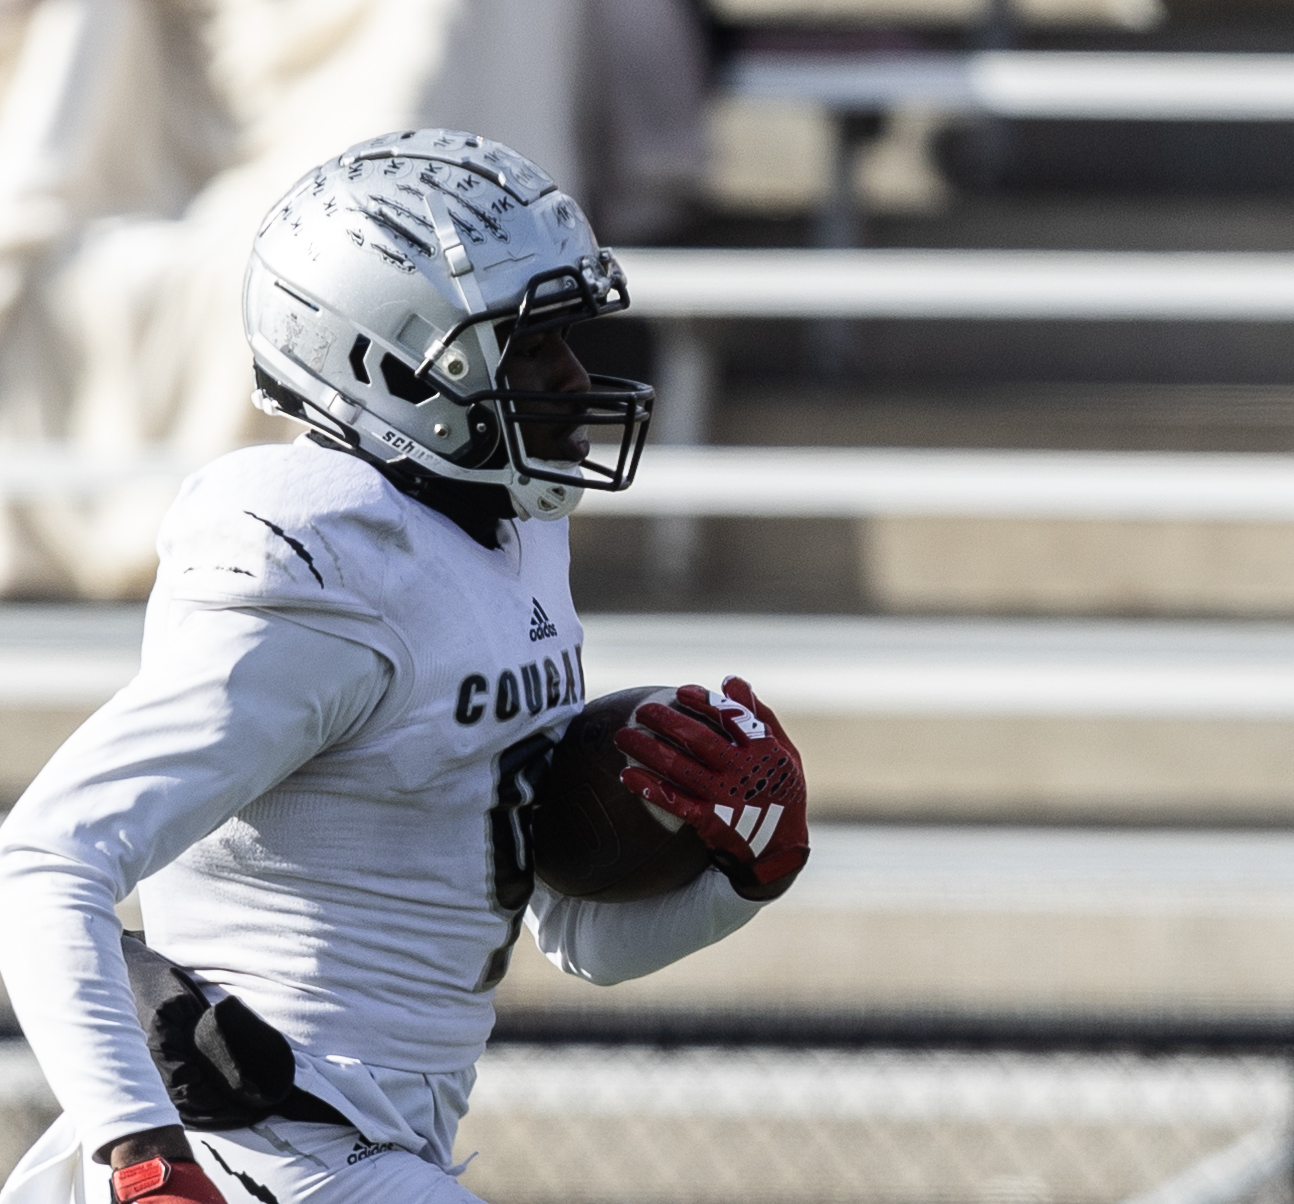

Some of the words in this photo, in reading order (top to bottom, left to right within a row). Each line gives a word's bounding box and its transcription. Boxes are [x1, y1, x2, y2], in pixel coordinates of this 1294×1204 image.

[384, 159, 405, 175] 1K
[457, 174, 480, 192] 1K
[491, 196, 514, 214] 1K
